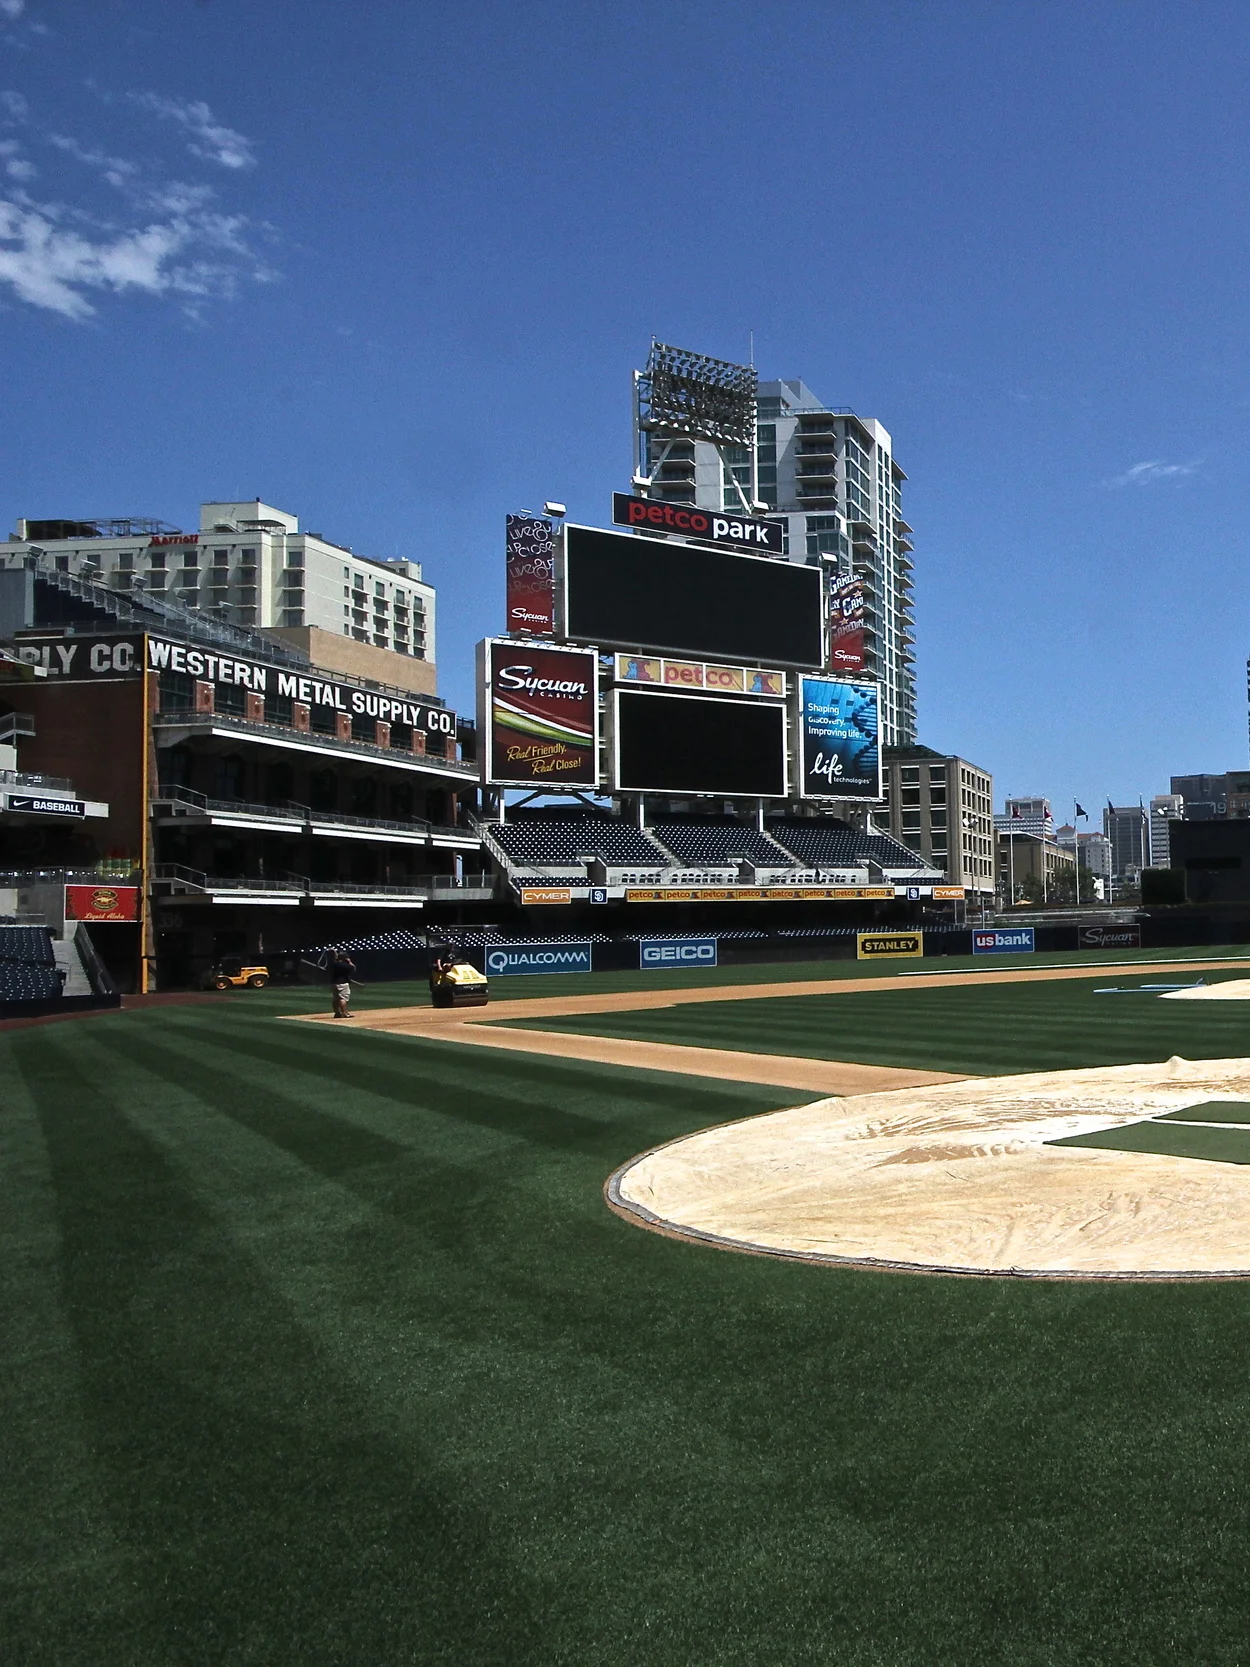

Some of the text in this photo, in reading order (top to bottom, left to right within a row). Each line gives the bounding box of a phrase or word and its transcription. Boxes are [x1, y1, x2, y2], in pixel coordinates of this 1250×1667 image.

[628, 502, 769, 544] petco park
[151, 534, 199, 546] Marriott
[511, 607, 549, 622] Sycuan
[90, 642, 141, 673] CO.
[834, 650, 861, 662] Sycuan
[498, 665, 588, 696] Sycuan
[664, 665, 734, 686] petco
[148, 639, 455, 735] WESTERN METAL SUPPLY CO.
[540, 692, 583, 701] CASINO
[808, 703, 840, 716] Shaping
[808, 726, 862, 739] Improving life.
[507, 743, 567, 762] Real Friendly.
[532, 757, 581, 775] Real Close!
[809, 752, 843, 785] life
[33, 801, 80, 813] BASEBALL
[1210, 802, 1227, 814] 19
[524, 892, 569, 900] CYMER
[772, 890, 793, 898] petco
[866, 889, 885, 897] petco
[1085, 928, 1138, 946] Sycuan
[643, 945, 715, 961] GEICO
[865, 940, 914, 951] STANLEY
[488, 951, 587, 972] QUALCOMM
